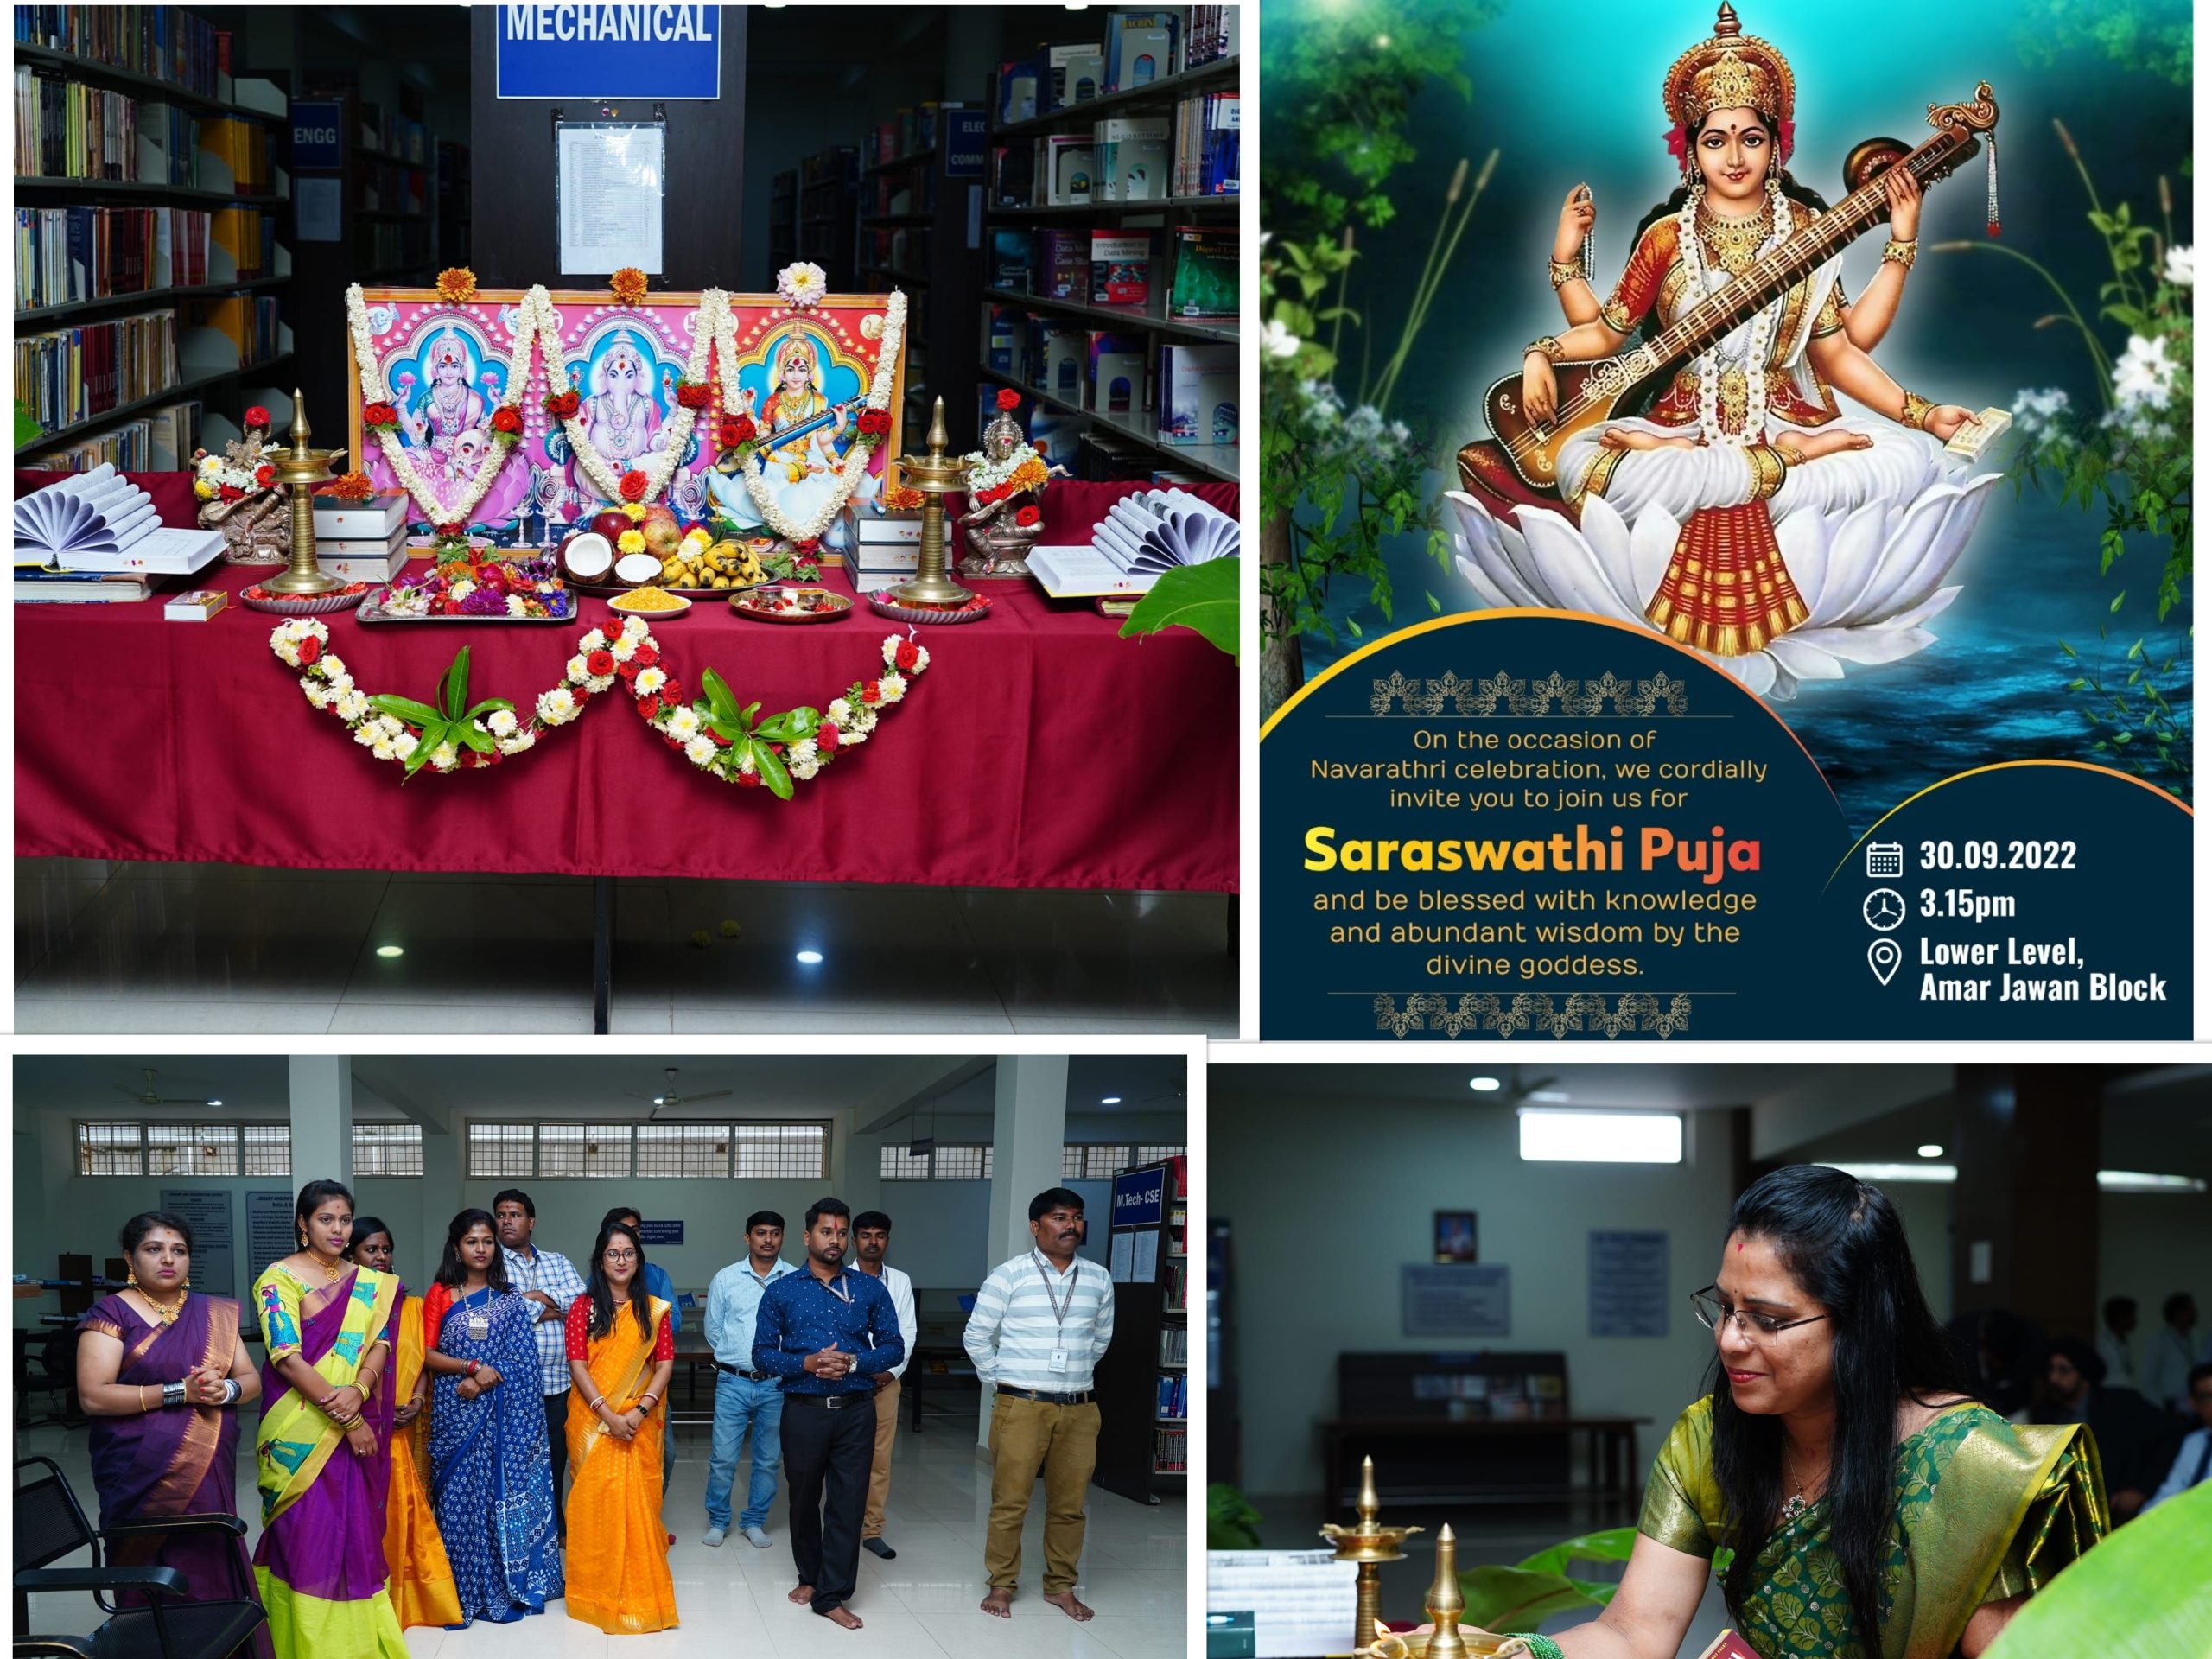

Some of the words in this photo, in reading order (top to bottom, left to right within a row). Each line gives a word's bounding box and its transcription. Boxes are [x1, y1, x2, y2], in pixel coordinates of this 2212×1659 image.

[506, 5, 712, 41] MECHANICAL
[293, 127, 337, 145] ENGG
[1414, 730, 1447, 749] On
[1458, 730, 1499, 749] the
[1507, 730, 1621, 749] occasion
[1630, 730, 1657, 749] of
[1311, 760, 1446, 779] Navarathri
[1454, 760, 1606, 781] celebration,
[1614, 764, 1651, 779] we
[1658, 760, 1768, 783] cordially
[1390, 789, 1461, 808] invite
[1469, 791, 1514, 811] you
[1524, 789, 1549, 808] to
[1554, 789, 1603, 811] join
[1612, 791, 1642, 808] us
[1650, 789, 1688, 808] for
[1303, 823, 1624, 873] Saraswathi
[1640, 825, 1761, 885] Puja
[1919, 841, 2077, 870] 30.09.2022
[1313, 890, 1365, 911] and
[1376, 890, 1408, 911] be
[1419, 890, 1525, 911] blessed
[1535, 890, 1596, 911] with
[1605, 890, 1757, 914] knowledge
[1919, 888, 2016, 923] 3.15pm
[1330, 922, 1381, 943] and
[1390, 922, 1527, 943] abundant
[1535, 922, 1643, 943] wisdom
[1654, 922, 1685, 947] by
[1694, 922, 1740, 943] the
[1920, 937, 1999, 966] Lower
[2007, 937, 2084, 969] Level,
[1426, 955, 1510, 976] divine
[1519, 955, 1643, 979] goddess.
[1919, 973, 1992, 1001] Amar
[1999, 973, 2080, 1001] Jawan
[2089, 973, 2168, 1001] Block
[1145, 1189, 1160, 1204] CSE
